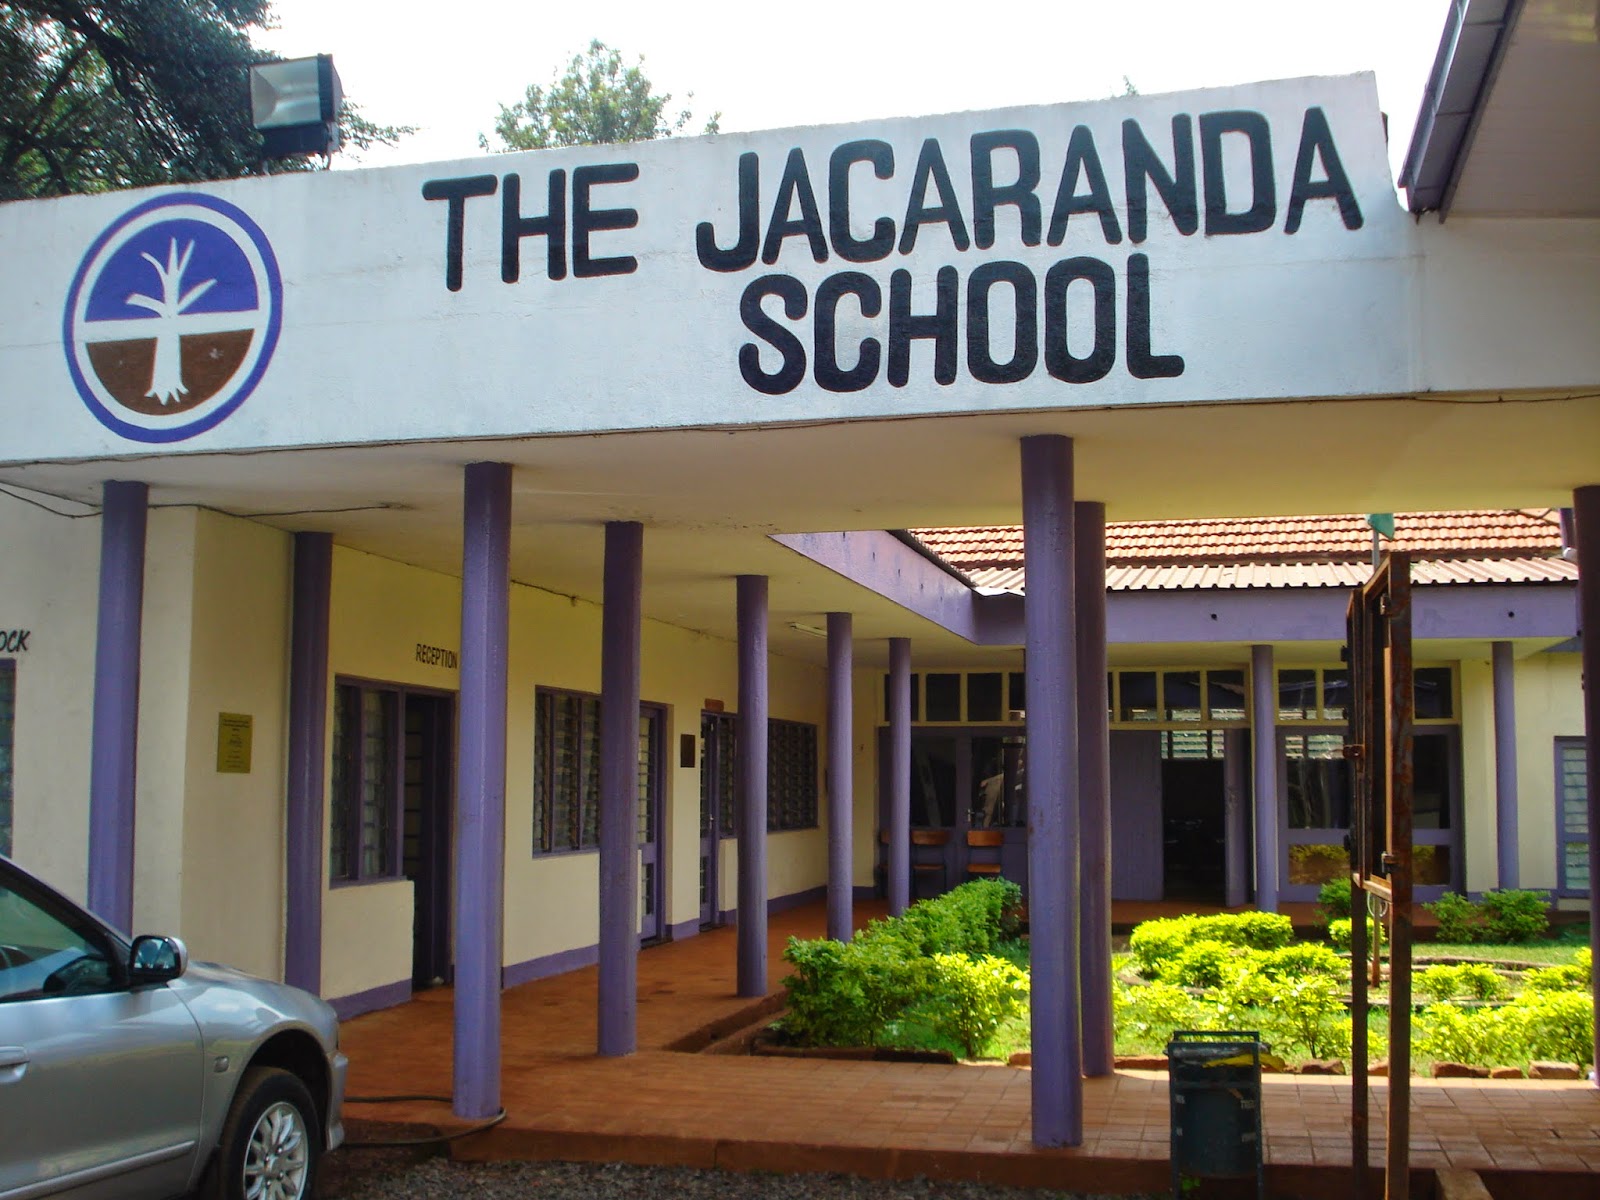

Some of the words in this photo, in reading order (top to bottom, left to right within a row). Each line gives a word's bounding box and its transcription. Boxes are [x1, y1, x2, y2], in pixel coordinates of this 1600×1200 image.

[421, 163, 640, 293] THE
[695, 106, 1364, 273] JACARANDA
[738, 252, 1185, 396] SCHOOL
[415, 643, 458, 670] RECEPTION
